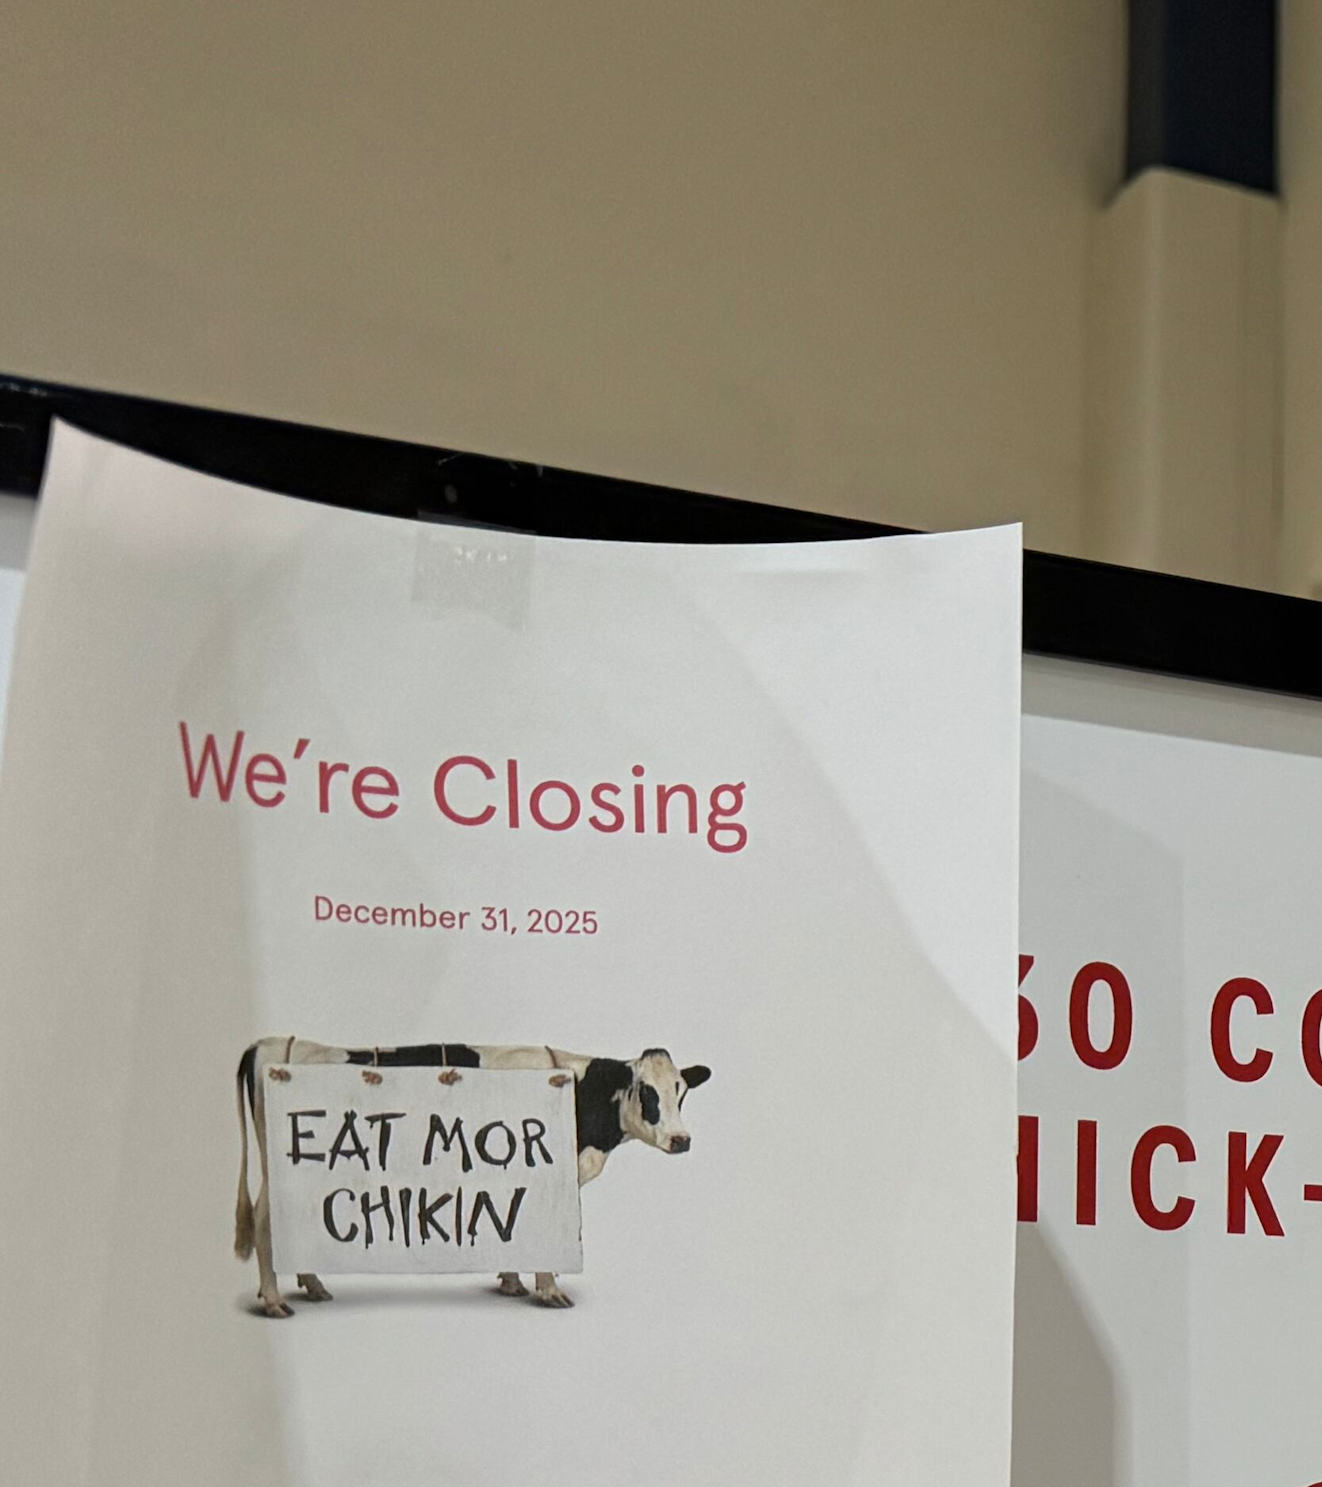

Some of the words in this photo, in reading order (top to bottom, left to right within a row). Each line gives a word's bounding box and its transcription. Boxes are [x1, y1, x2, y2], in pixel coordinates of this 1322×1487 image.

[180, 722, 399, 820] We're
[433, 755, 748, 854] Closing
[313, 895, 468, 930] December
[482, 906, 516, 934] 31,
[527, 908, 599, 937] 2025
[286, 1109, 407, 1172] EAT
[422, 1113, 554, 1174] MOR
[322, 1185, 527, 1250] CHIKIN
